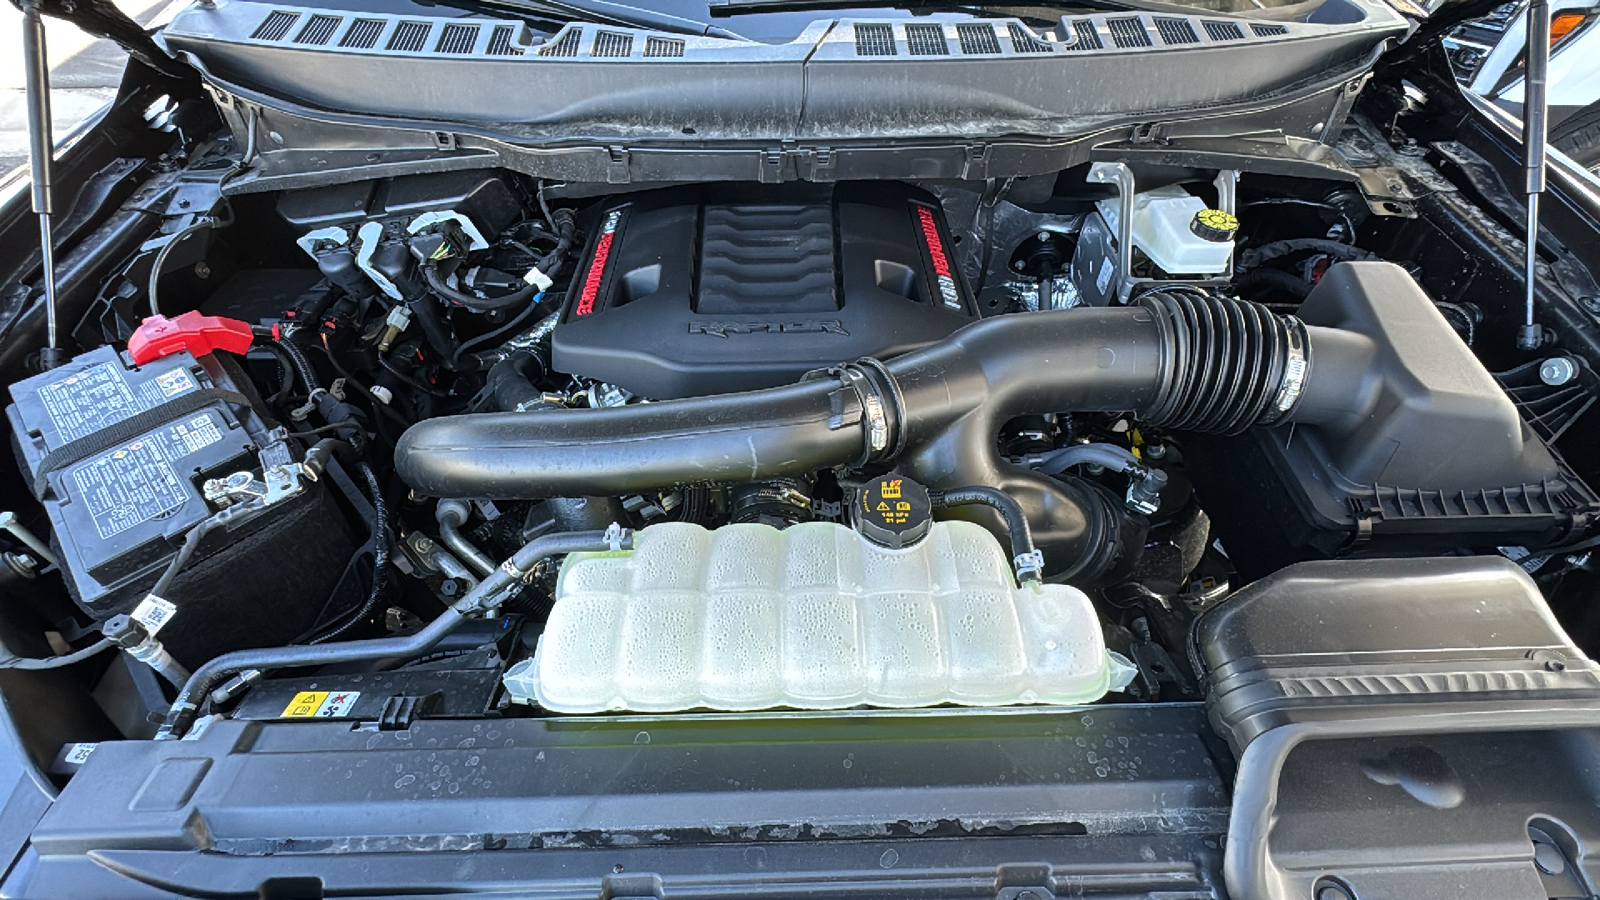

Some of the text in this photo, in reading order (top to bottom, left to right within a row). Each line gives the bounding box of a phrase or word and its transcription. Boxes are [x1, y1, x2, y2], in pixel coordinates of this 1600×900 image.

[576, 232, 615, 316] PERFORMANCE
[917, 205, 961, 310] FORD PERFORMANCE
